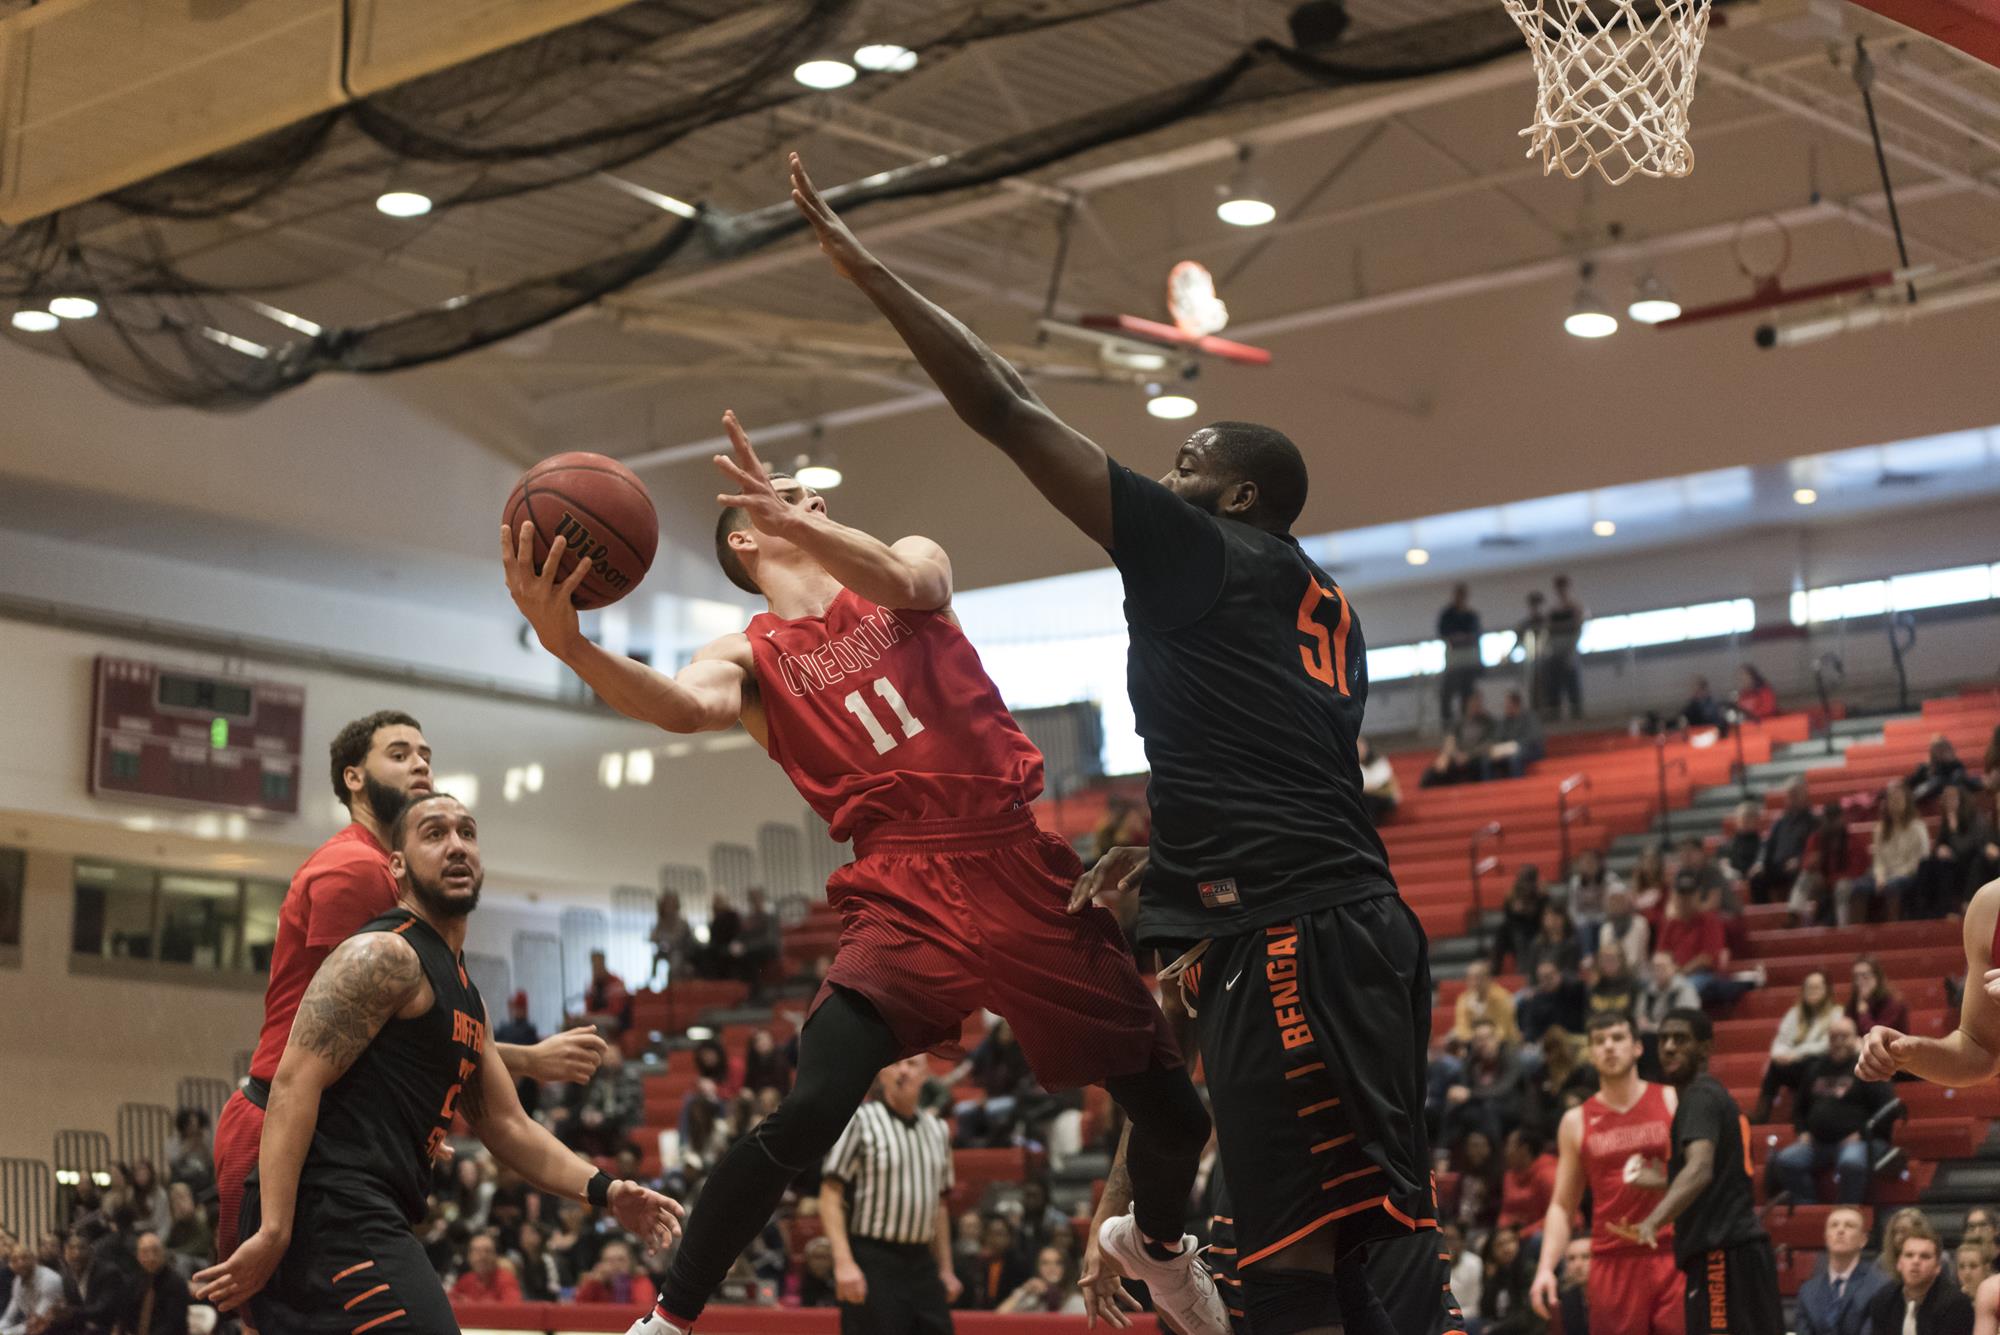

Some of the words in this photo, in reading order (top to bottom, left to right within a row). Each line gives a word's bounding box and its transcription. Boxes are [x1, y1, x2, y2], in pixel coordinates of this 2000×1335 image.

[554, 511, 629, 590] Wilson
[778, 605, 912, 696] ONEONTA
[845, 676, 925, 755] 11
